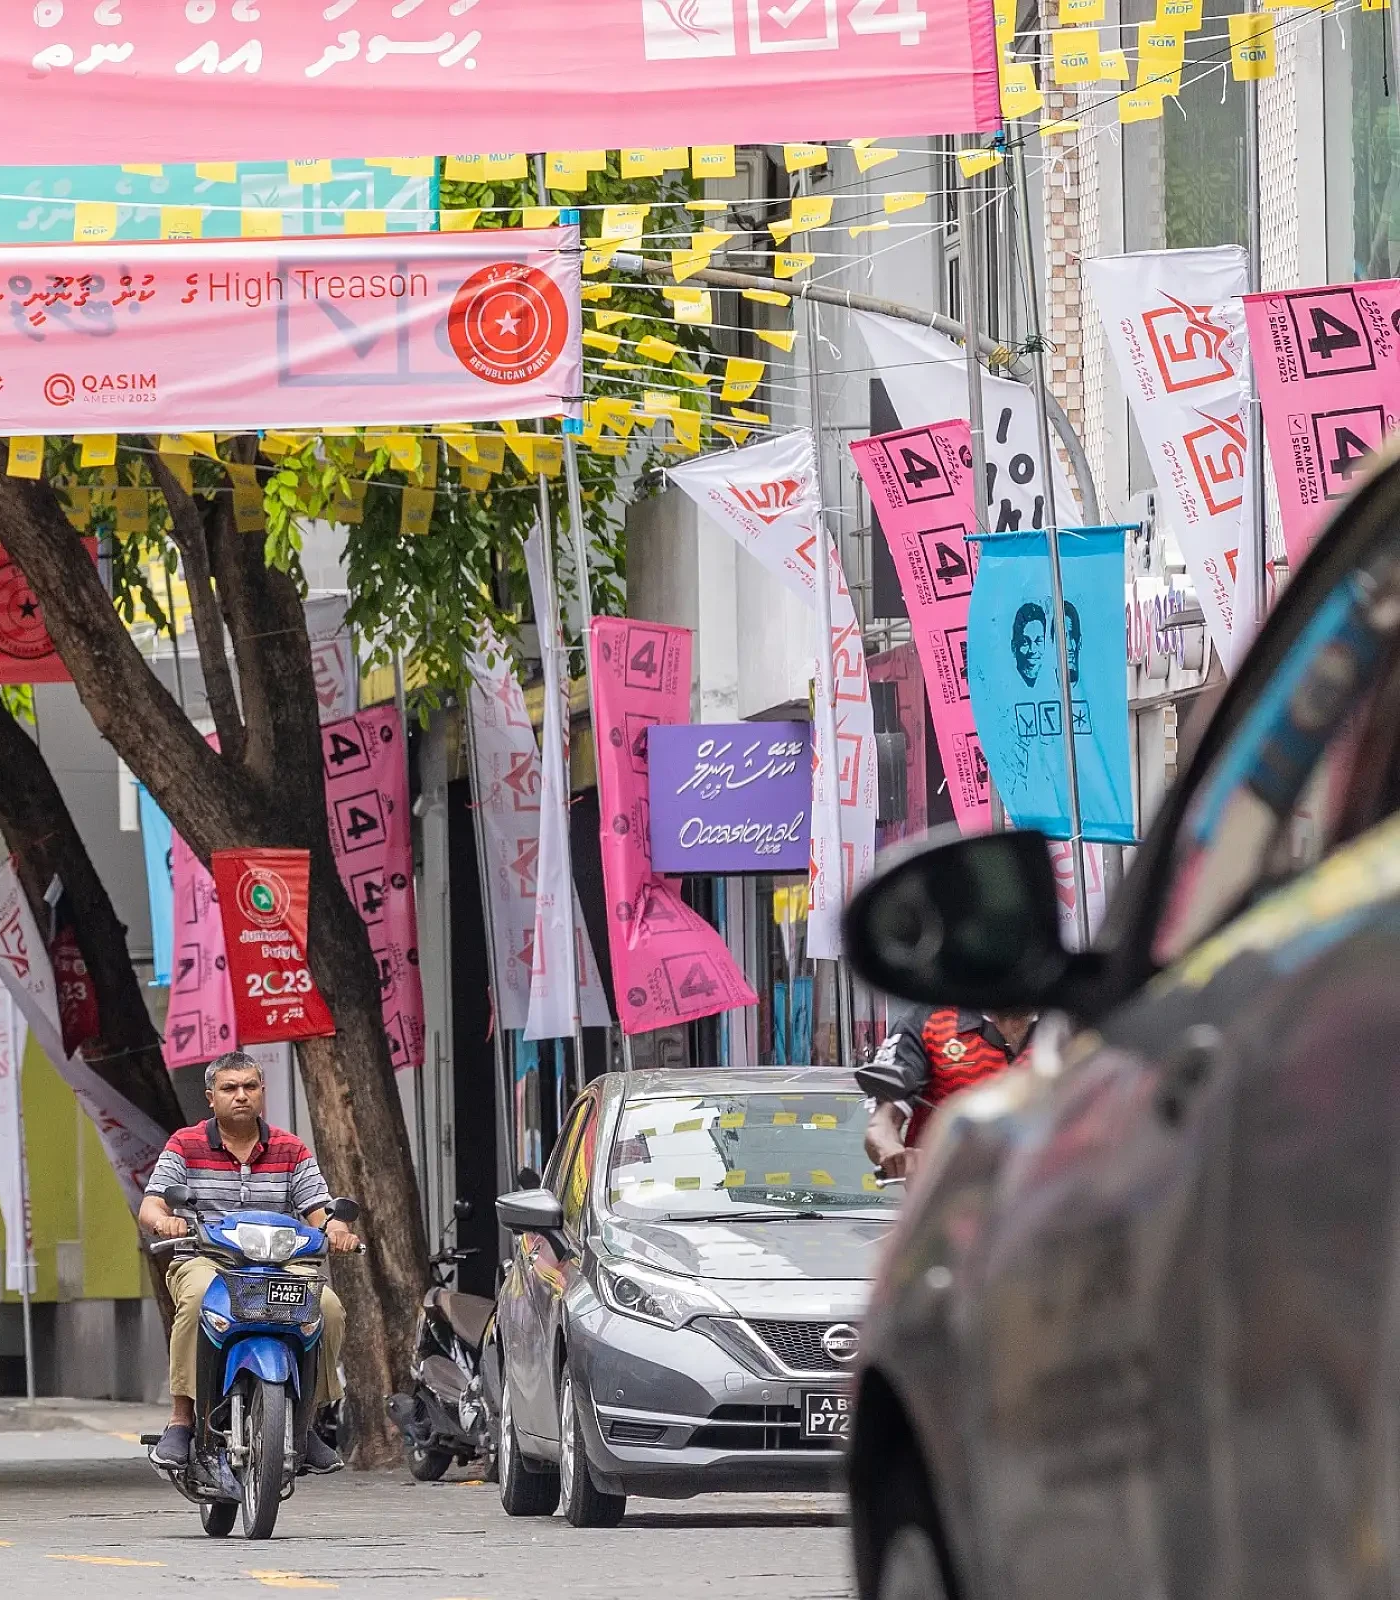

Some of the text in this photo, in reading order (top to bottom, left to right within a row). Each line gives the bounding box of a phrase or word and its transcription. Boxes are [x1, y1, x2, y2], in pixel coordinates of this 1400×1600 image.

[1164, 4, 1194, 15] MDP
[455, 153, 482, 163] MDP
[488, 151, 515, 162] MDP
[700, 155, 727, 164] MDP
[82, 227, 109, 236] MDP
[209, 272, 284, 307] High
[295, 269, 428, 299] Treason
[1162, 329, 1216, 367] 5
[1269, 316, 1289, 383] SEMBE 2023
[1277, 314, 1299, 383] DR.MUIZZU
[1307, 307, 1362, 359] 4
[82, 374, 157, 393] QASIM
[469, 350, 553, 381] REPUBLICAN PARTY
[83, 393, 157, 403] AMEEN 2023
[897, 446, 942, 489] 4
[1291, 437, 1310, 505] SEMBE 2023
[1300, 436, 1319, 504] DR.MUIZZU
[1330, 425, 1375, 481] 4
[870, 457, 897, 509] SEMBE 2023
[877, 455, 904, 508] DR.MUIZZU
[913, 549, 933, 605] DR.MUIZZU
[934, 541, 970, 586] 4
[329, 733, 361, 766] 4
[347, 807, 378, 840] 4
[680, 811, 804, 848] Occasional
[271, 1291, 302, 1303] P1457
[810, 1413, 851, 1432] P72
[820, 1398, 832, 1411] A
